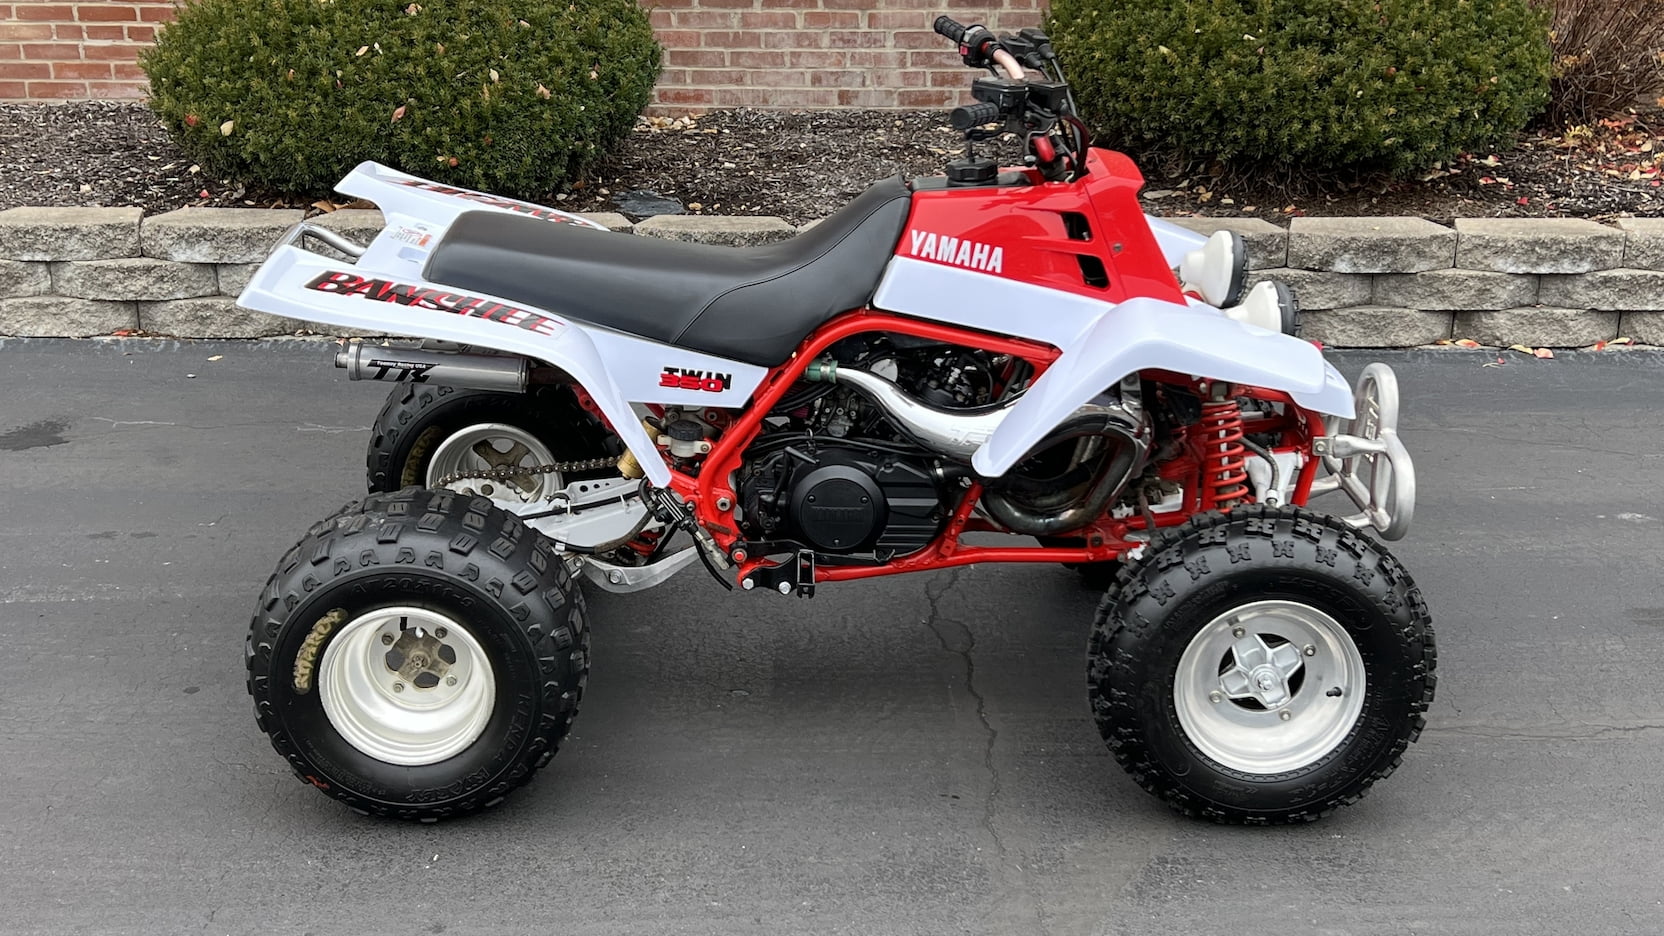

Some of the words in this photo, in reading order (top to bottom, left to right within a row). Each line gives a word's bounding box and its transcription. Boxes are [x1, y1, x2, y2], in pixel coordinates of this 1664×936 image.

[910, 228, 1004, 274] YAMAHA
[304, 270, 567, 337] BANSHEE
[659, 373, 724, 393] 350
